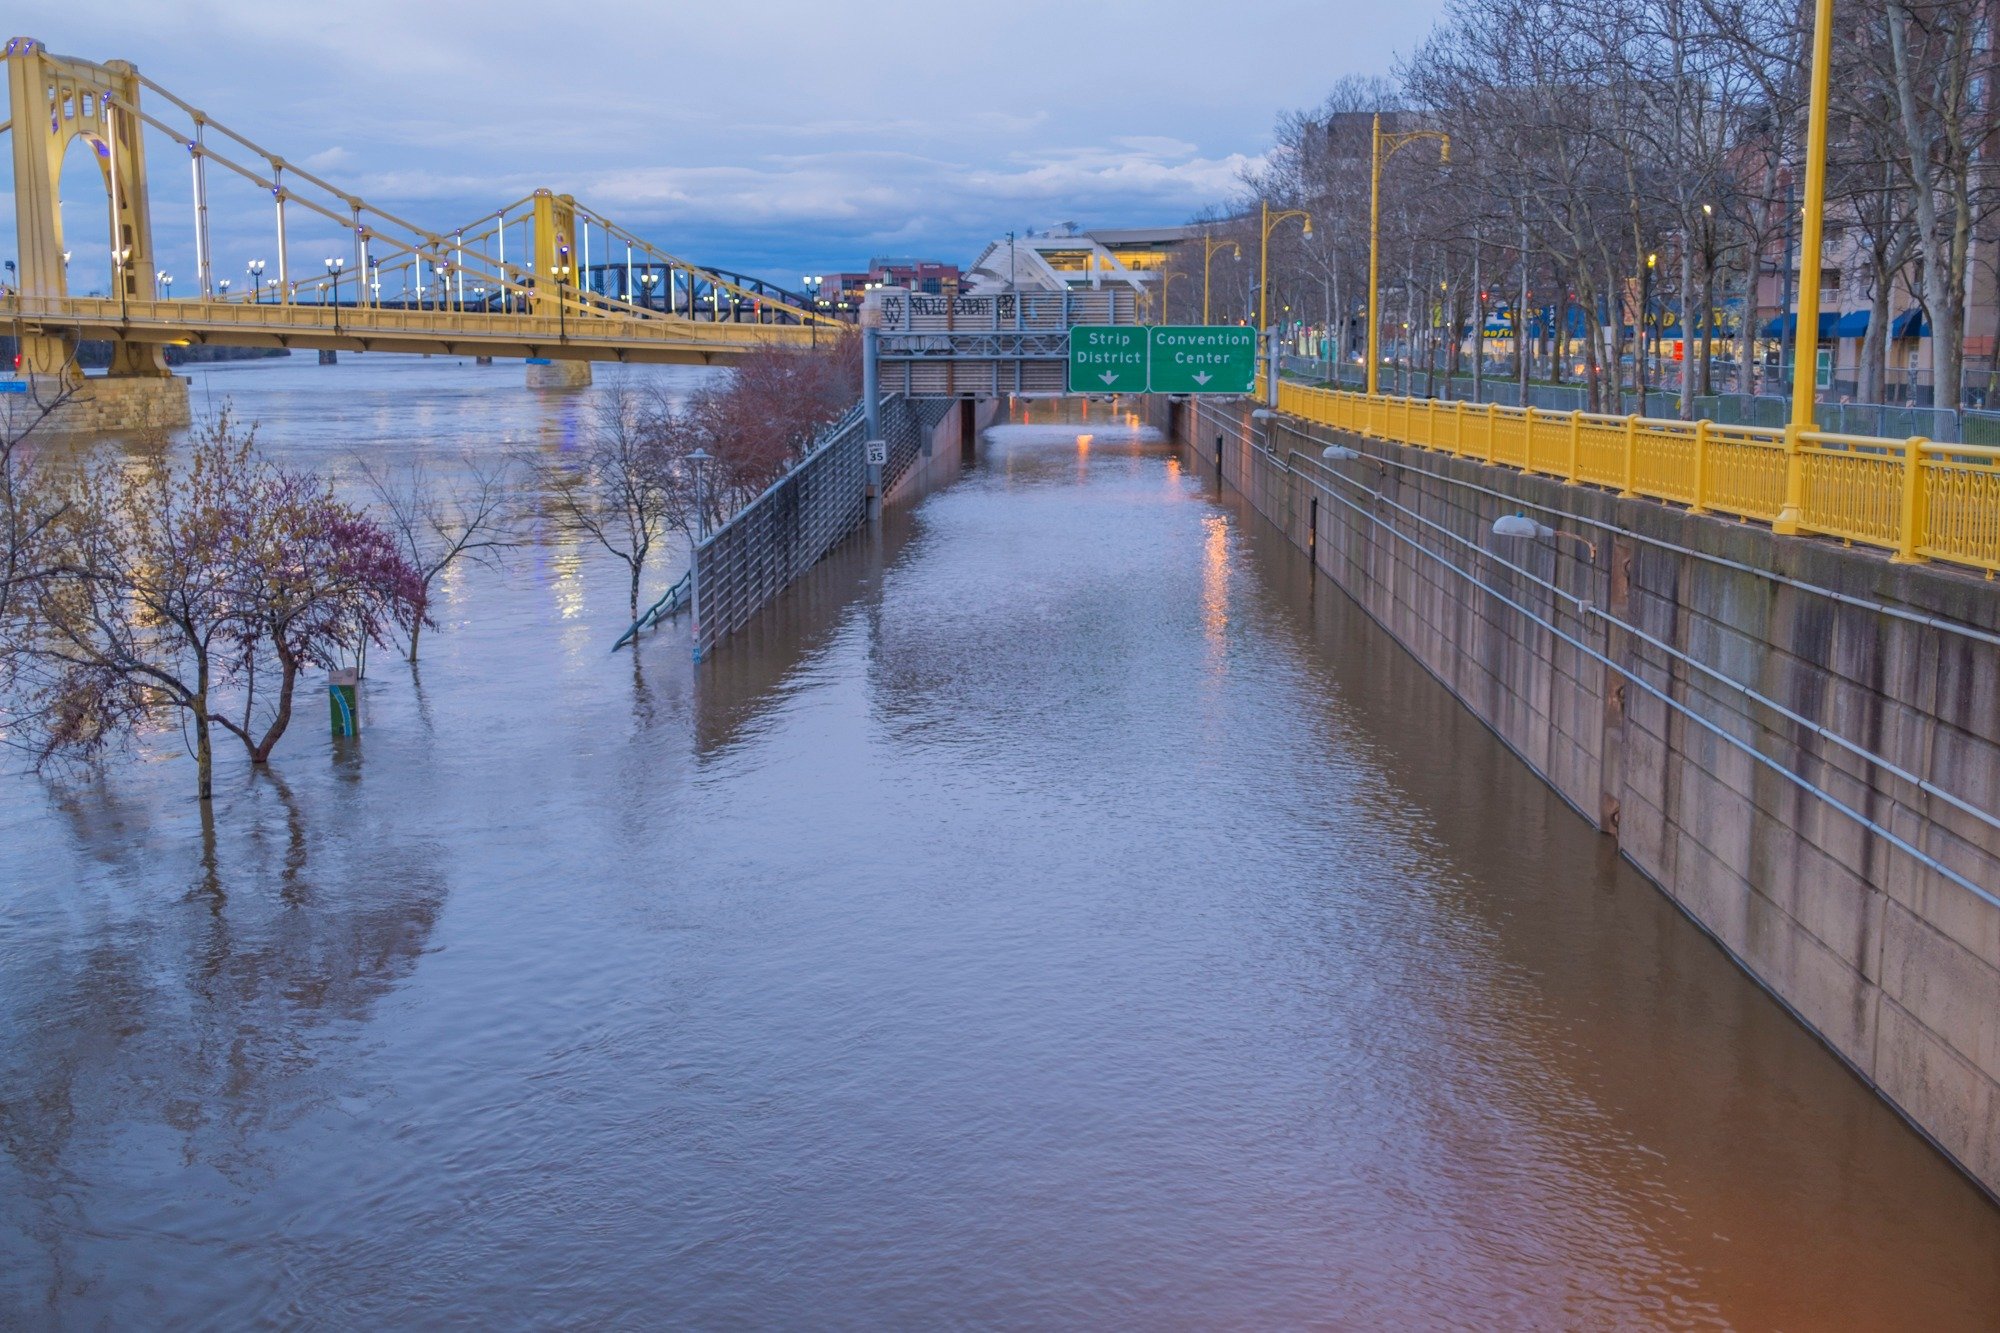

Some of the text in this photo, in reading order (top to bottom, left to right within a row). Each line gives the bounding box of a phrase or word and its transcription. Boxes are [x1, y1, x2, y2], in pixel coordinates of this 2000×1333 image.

[1089, 333, 1130, 346] Strip
[1156, 333, 1250, 345] Convention
[1077, 351, 1141, 363] District
[1175, 352, 1230, 364] Center
[869, 452, 883, 462] 35
